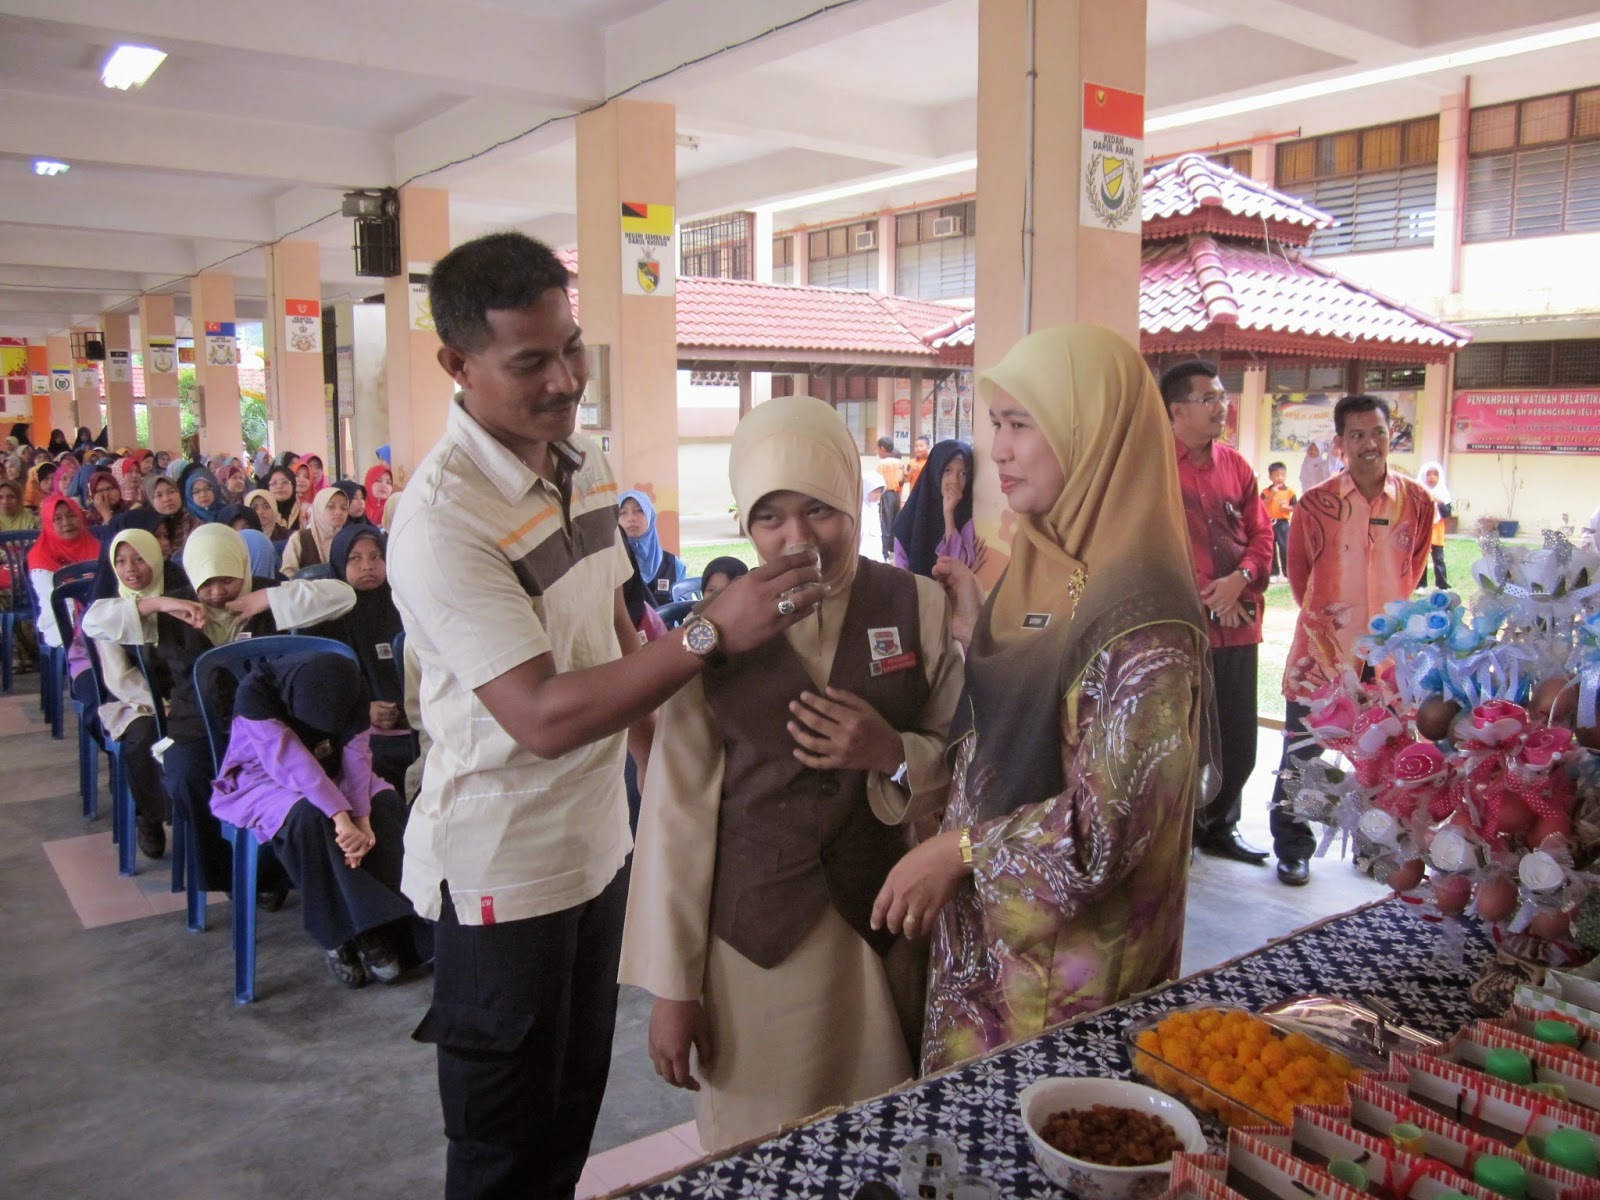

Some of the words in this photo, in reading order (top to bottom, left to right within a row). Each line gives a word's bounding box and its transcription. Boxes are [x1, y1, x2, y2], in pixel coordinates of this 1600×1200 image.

[1103, 134, 1124, 145] KEDAH
[1093, 141, 1113, 152] DARUL
[1115, 145, 1134, 156] AMAN
[1467, 395, 1520, 405] PENYAMPAIAN
[1522, 394, 1557, 405] WATIKAH
[894, 430, 910, 439] TM
